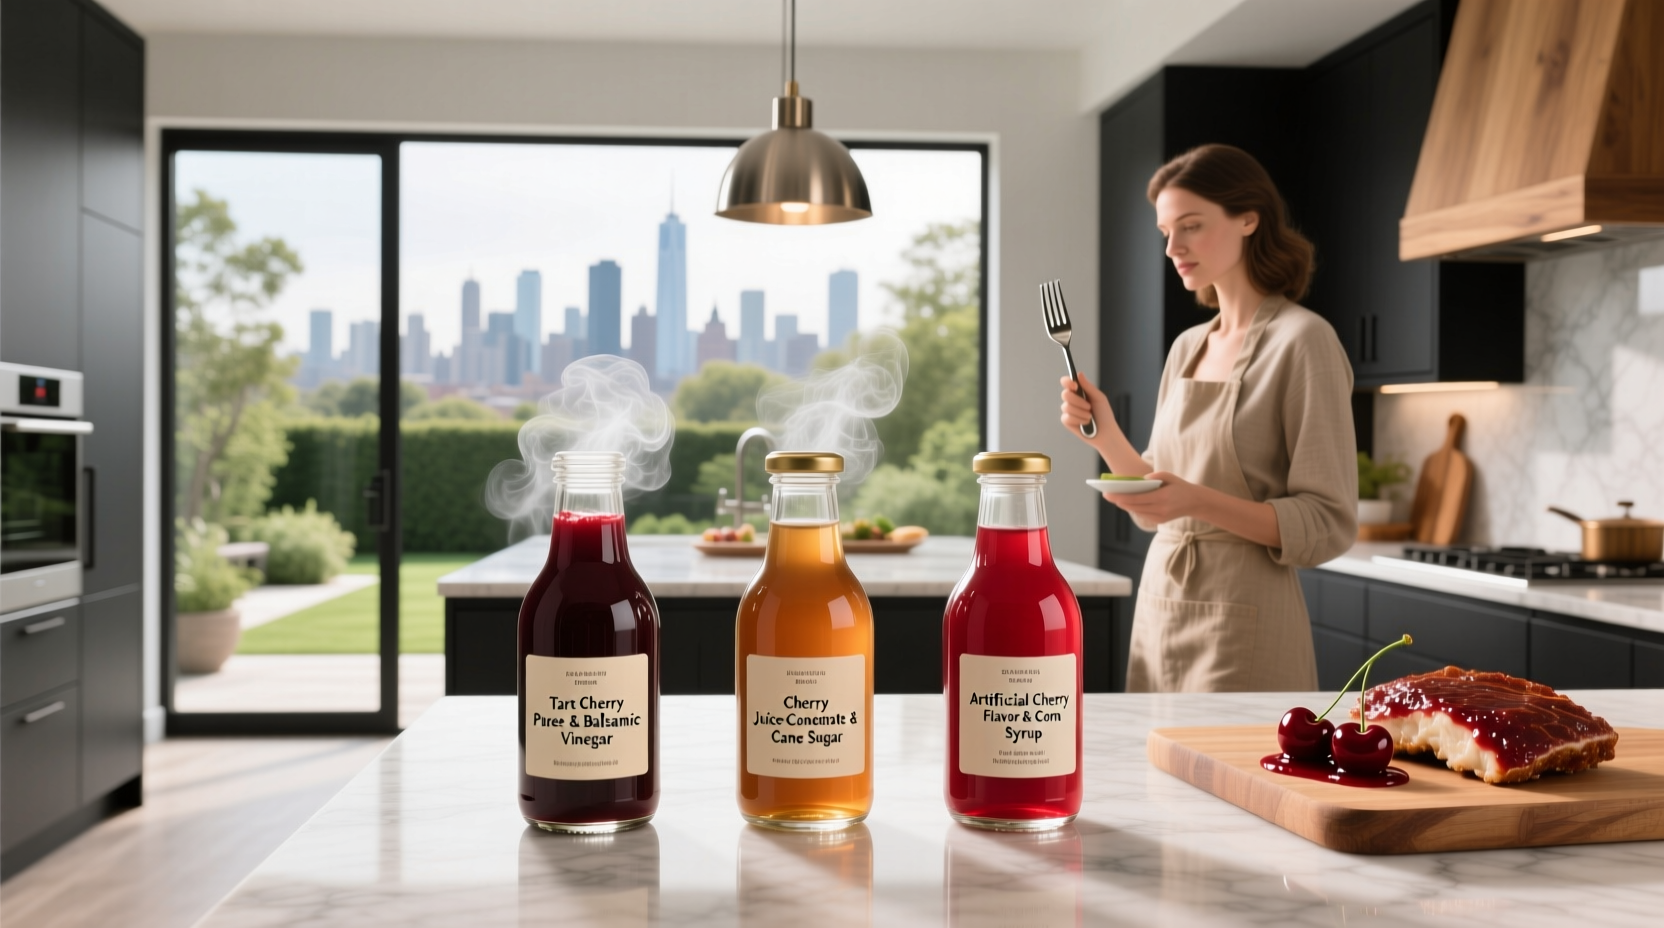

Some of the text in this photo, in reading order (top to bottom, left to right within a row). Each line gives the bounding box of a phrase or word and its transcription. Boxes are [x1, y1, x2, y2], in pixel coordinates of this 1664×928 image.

[549, 696, 624, 712] Tart Cherry
[784, 695, 829, 712] Cherry
[970, 692, 1029, 706] Artificial
[569, 715, 580, 727] &
[584, 713, 641, 728] Balsamic
[984, 709, 1020, 722] Flavor
[1023, 711, 1032, 722] &
[561, 732, 613, 749] Vinegar
[808, 731, 843, 747] Sugar
[1005, 726, 1043, 743] Syrup
